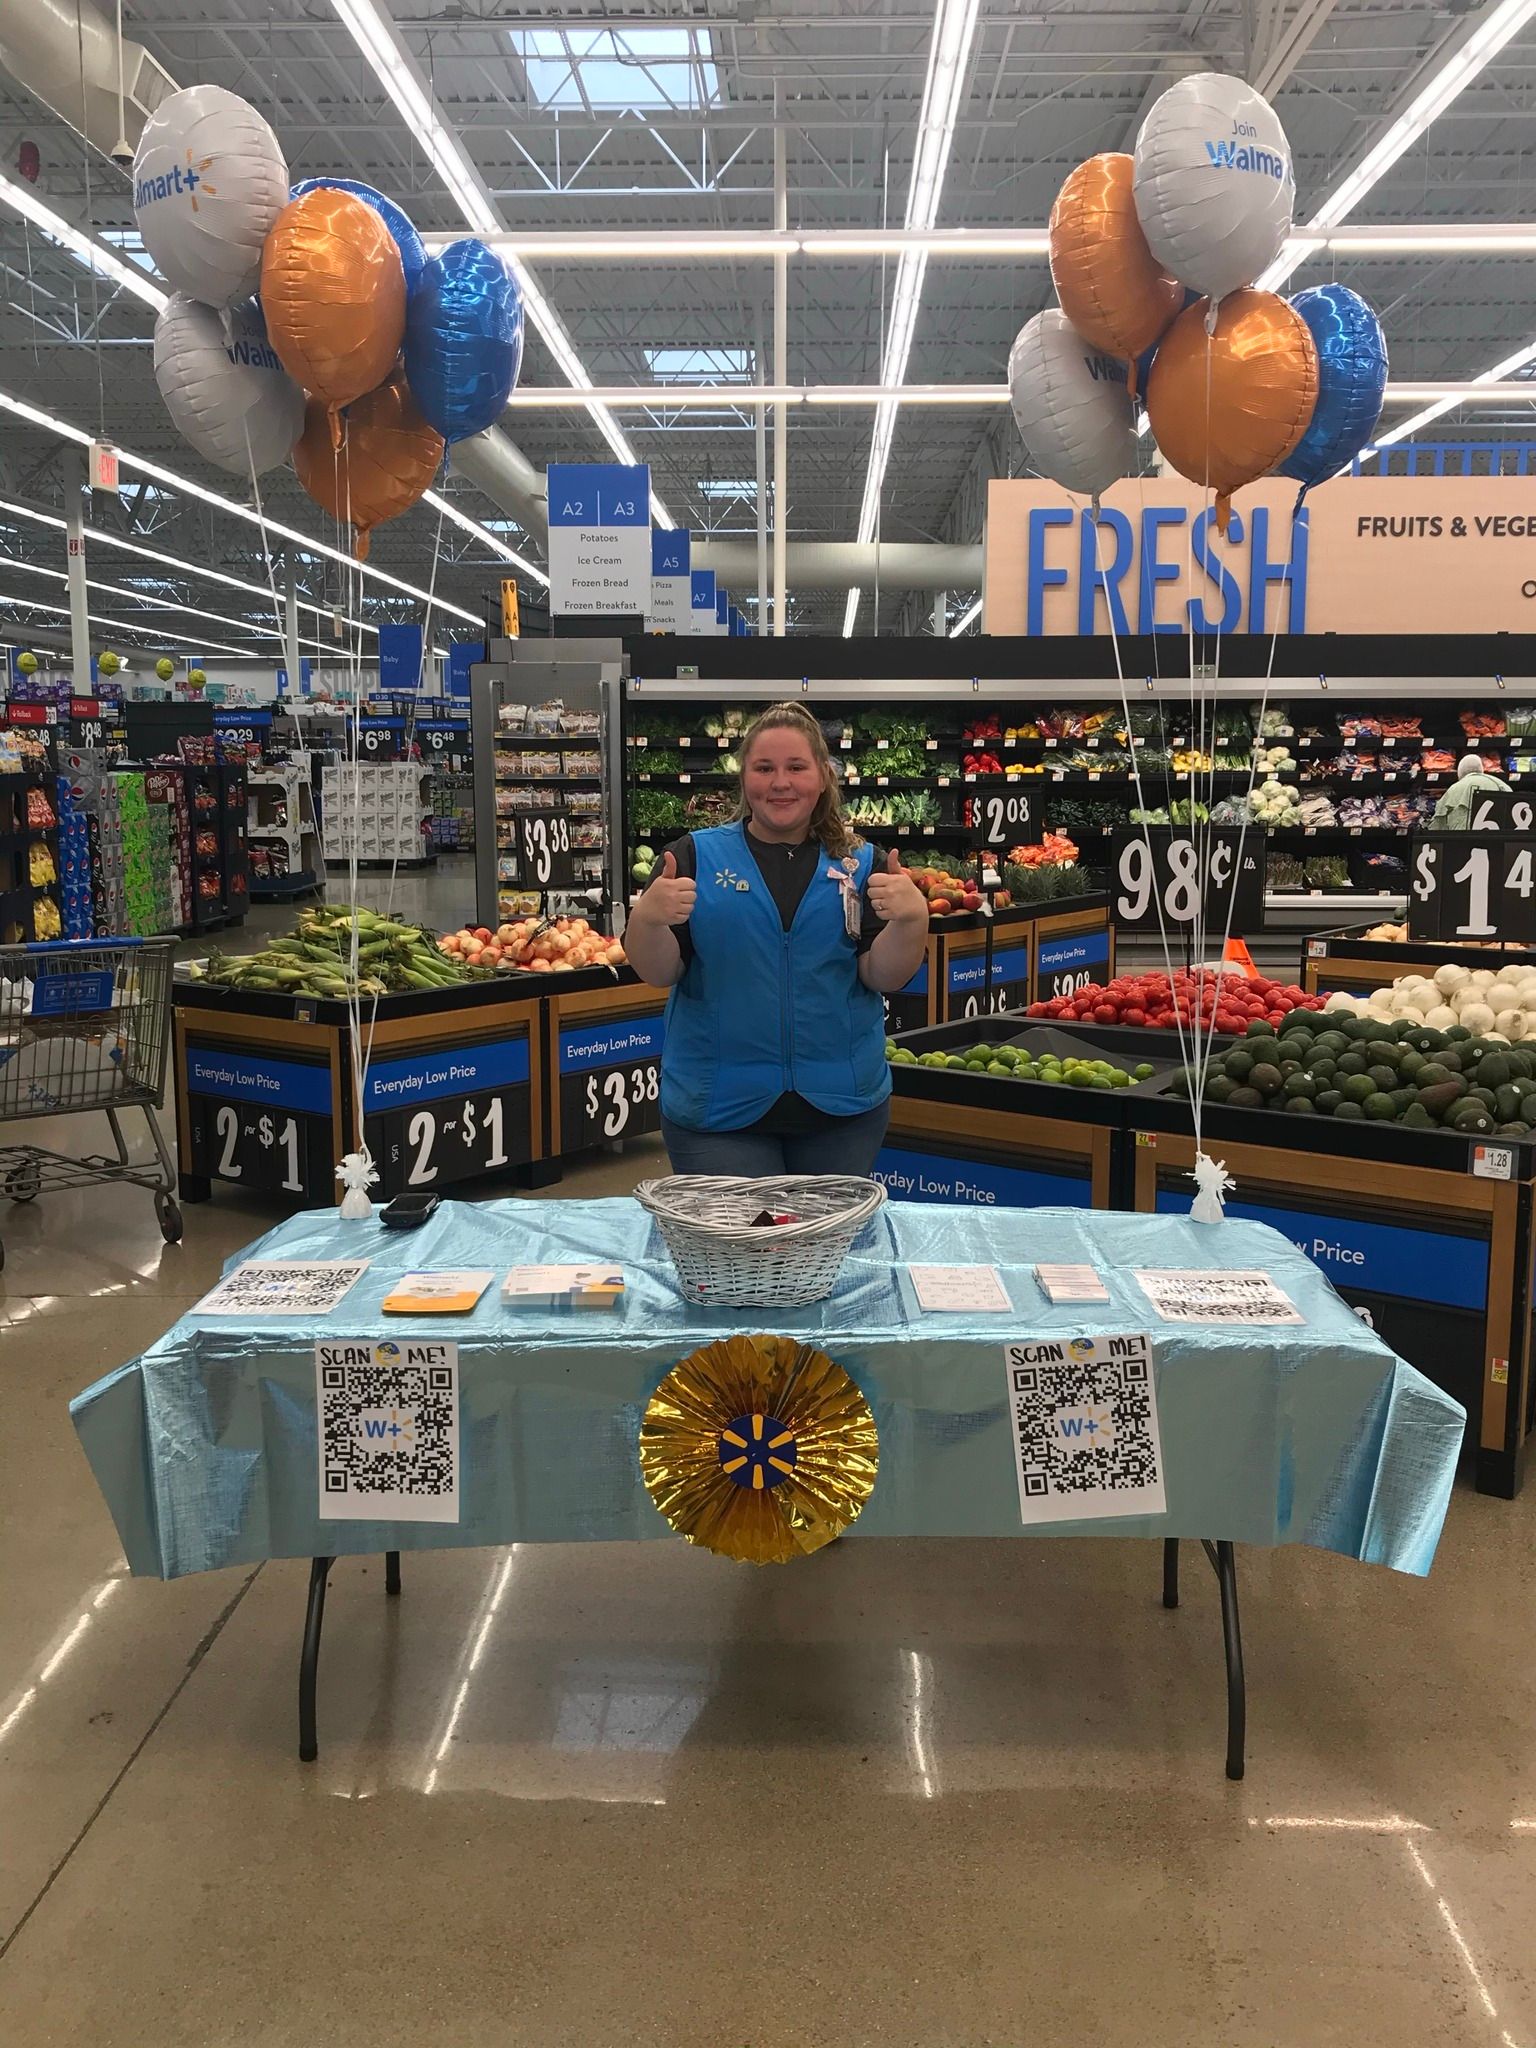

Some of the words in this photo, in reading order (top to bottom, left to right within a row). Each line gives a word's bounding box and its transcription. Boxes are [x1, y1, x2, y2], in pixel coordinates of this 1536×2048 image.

[1232, 119, 1257, 137] Join
[1205, 140, 1283, 179] Walma
[101, 454, 116, 486] EXIT
[562, 502, 583, 516] A2
[614, 502, 635, 516] A3
[1357, 516, 1443, 537] FRUITS
[1450, 516, 1467, 537] &
[1474, 516, 1536, 537] VEGE
[580, 533, 619, 542] Potatoes
[577, 556, 591, 565] Ice
[593, 556, 622, 565] Cream
[662, 557, 679, 568] A5
[1026, 507, 1309, 636] FRESH
[572, 579, 601, 587] Frozen
[603, 578, 629, 587] Bread
[655, 581, 673, 589] Pizza
[564, 601, 594, 610] Frozen
[597, 601, 637, 610] Breakfast
[693, 594, 706, 602] A7
[383, 655, 399, 664] Baby
[972, 796, 1031, 844] $208
[525, 817, 569, 883] $338
[1243, 857, 1257, 870] lb.
[1413, 843, 1535, 935] $14
[1041, 952, 1064, 965] Everyday
[1064, 950, 1074, 960] Low
[1074, 947, 1086, 957] Price
[953, 967, 978, 982] Everyday
[567, 1040, 608, 1058] Everyday
[610, 1038, 628, 1051] Low
[629, 1034, 651, 1048] Price
[195, 1063, 235, 1086] Everyday
[236, 1070, 255, 1086] Low
[257, 1074, 281, 1091] Price
[374, 1075, 423, 1094] Everyday
[425, 1070, 448, 1085] Low
[450, 1065, 477, 1080] Price
[217, 1106, 243, 1177] 2
[408, 1111, 439, 1185] 2
[391, 1144, 399, 1163] USA
[869, 1170, 915, 1194] ryday
[919, 1174, 951, 1196] Low
[955, 1181, 996, 1204] Price
[1312, 1238, 1365, 1265] Price
[320, 1347, 371, 1366] SCAN
[408, 1346, 446, 1364] ME!
[1010, 1343, 1064, 1366] SCAN
[1108, 1336, 1147, 1357] ME!
[364, 1420, 402, 1438] W+
[1060, 1418, 1099, 1437] W+
